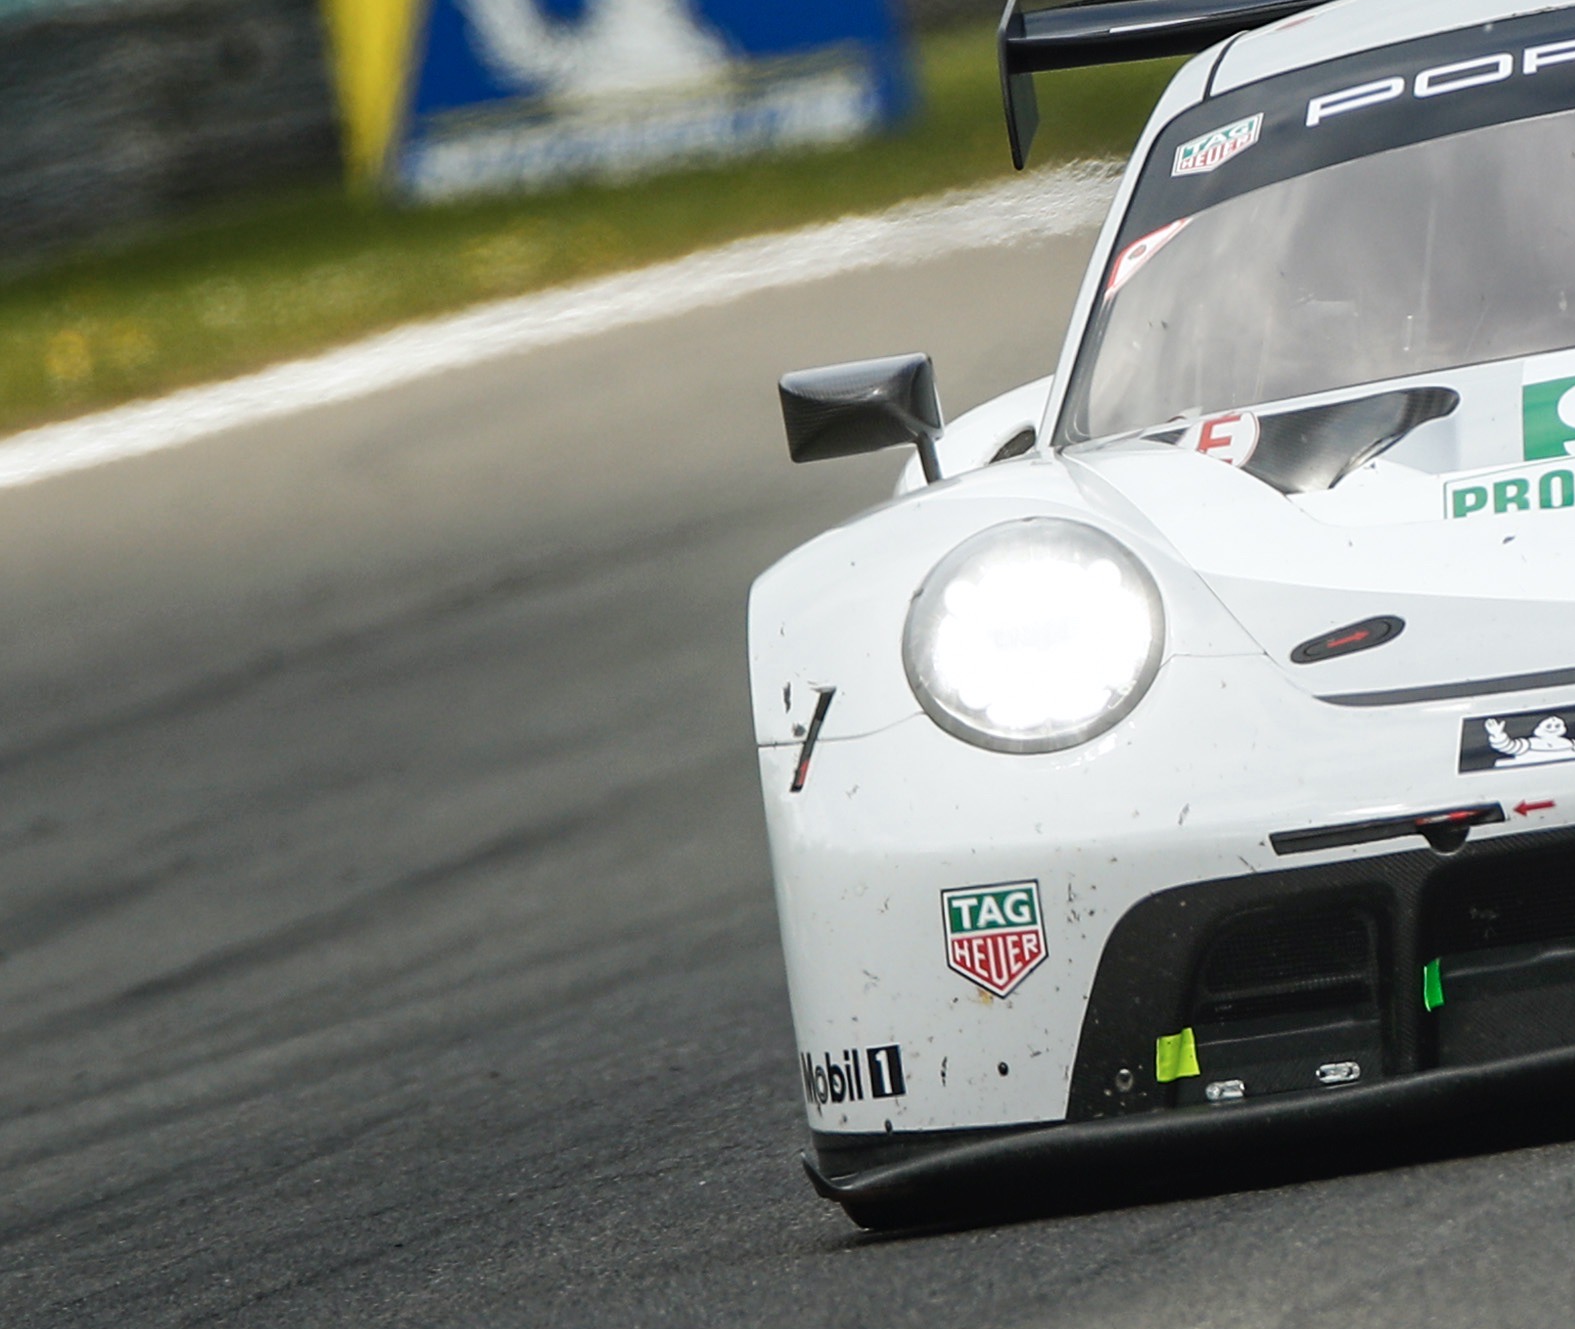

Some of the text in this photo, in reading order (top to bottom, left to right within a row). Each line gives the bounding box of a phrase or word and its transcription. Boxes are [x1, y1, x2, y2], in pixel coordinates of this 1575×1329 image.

[1452, 469, 1575, 519] PRO
[951, 891, 1033, 931] TAG
[953, 933, 1039, 987] HEUER
[870, 1048, 899, 1097] 1
